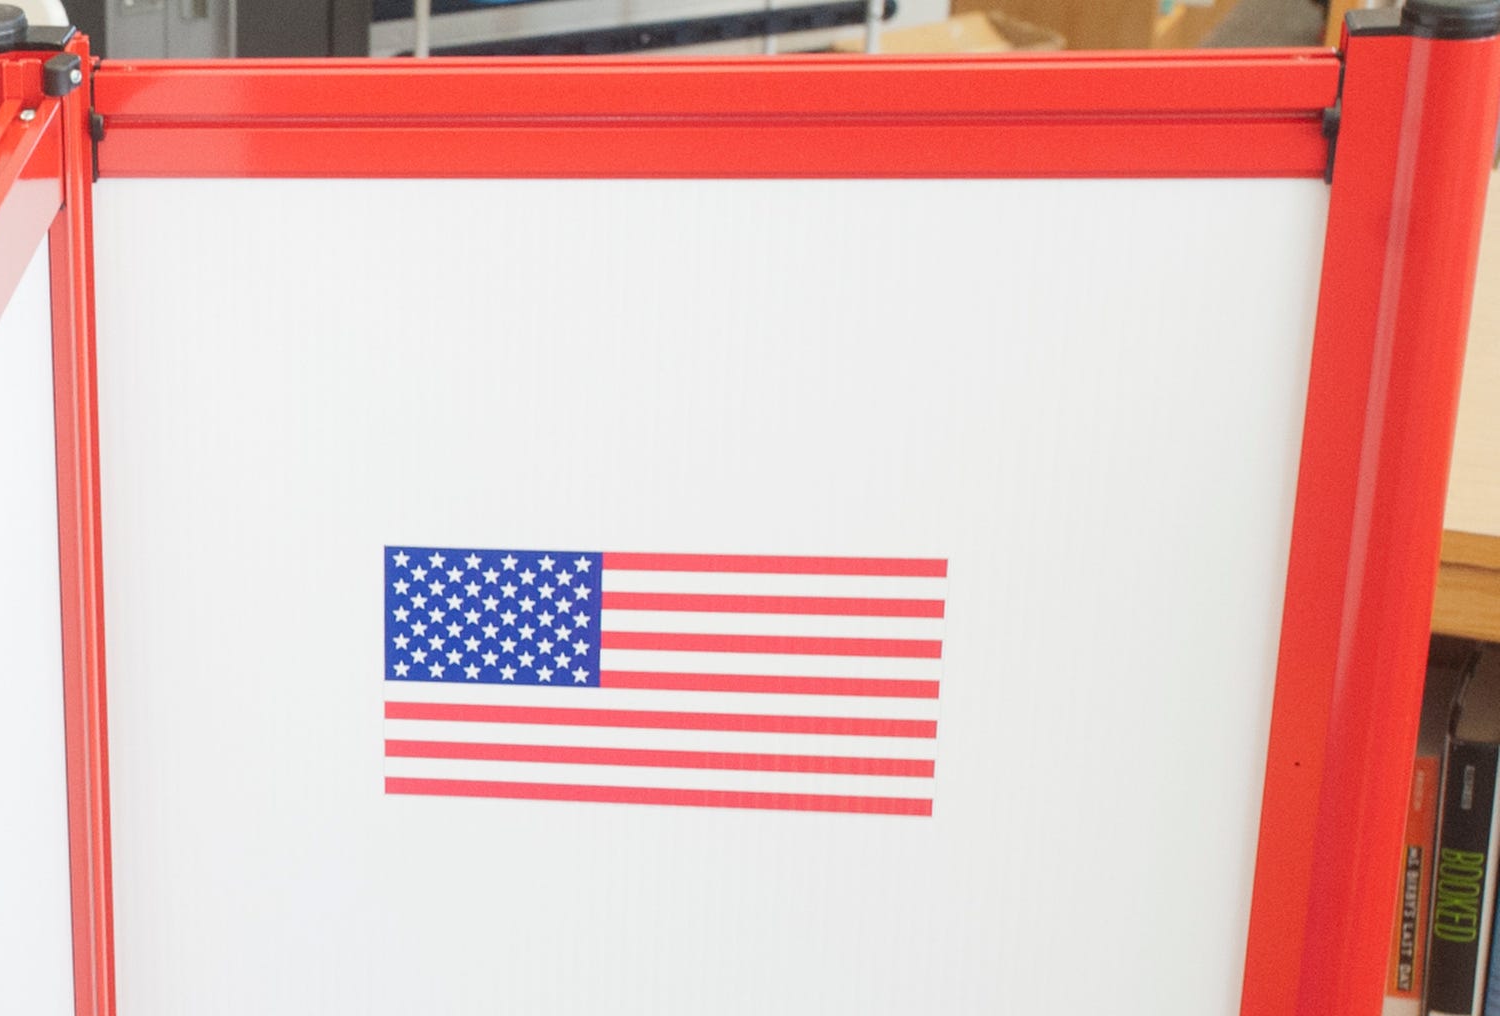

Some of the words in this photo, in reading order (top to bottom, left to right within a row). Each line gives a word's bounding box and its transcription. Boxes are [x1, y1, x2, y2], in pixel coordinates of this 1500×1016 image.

[1434, 847, 1484, 943] BOOKED
[1401, 922, 1415, 956] LAST
[1397, 963, 1411, 990] DAY
